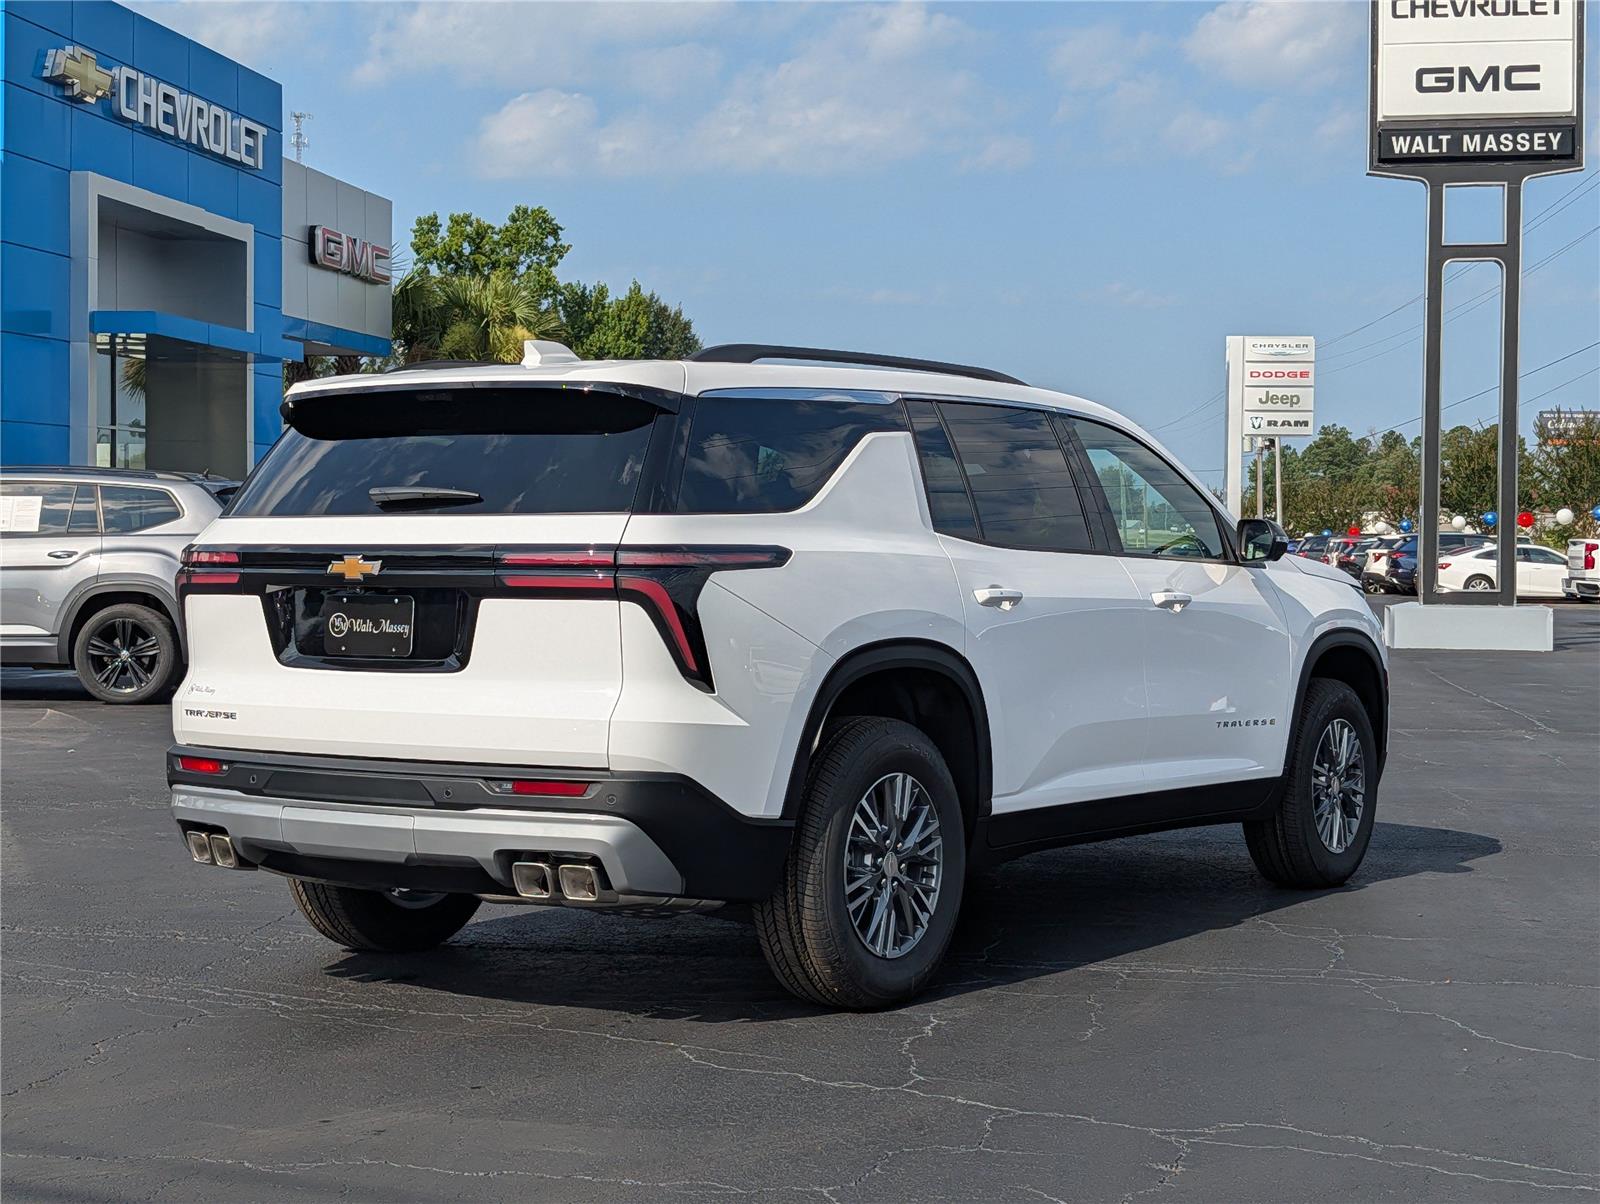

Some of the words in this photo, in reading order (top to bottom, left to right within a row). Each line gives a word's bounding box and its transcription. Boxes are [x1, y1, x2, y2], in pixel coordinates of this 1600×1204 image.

[1391, 0, 1561, 19] CHEVROLET
[1415, 64, 1541, 94] GMC
[113, 66, 268, 170] CHEVROLET
[1391, 135, 1452, 155] WALT
[1462, 132, 1563, 153] MASSEY
[315, 225, 392, 285] GMC
[1258, 390, 1301, 408] Jeep
[348, 618, 373, 633] Walt
[373, 618, 410, 638] Massey
[184, 708, 237, 720] TRAVERSE
[1215, 718, 1276, 728] TRAVERSE
